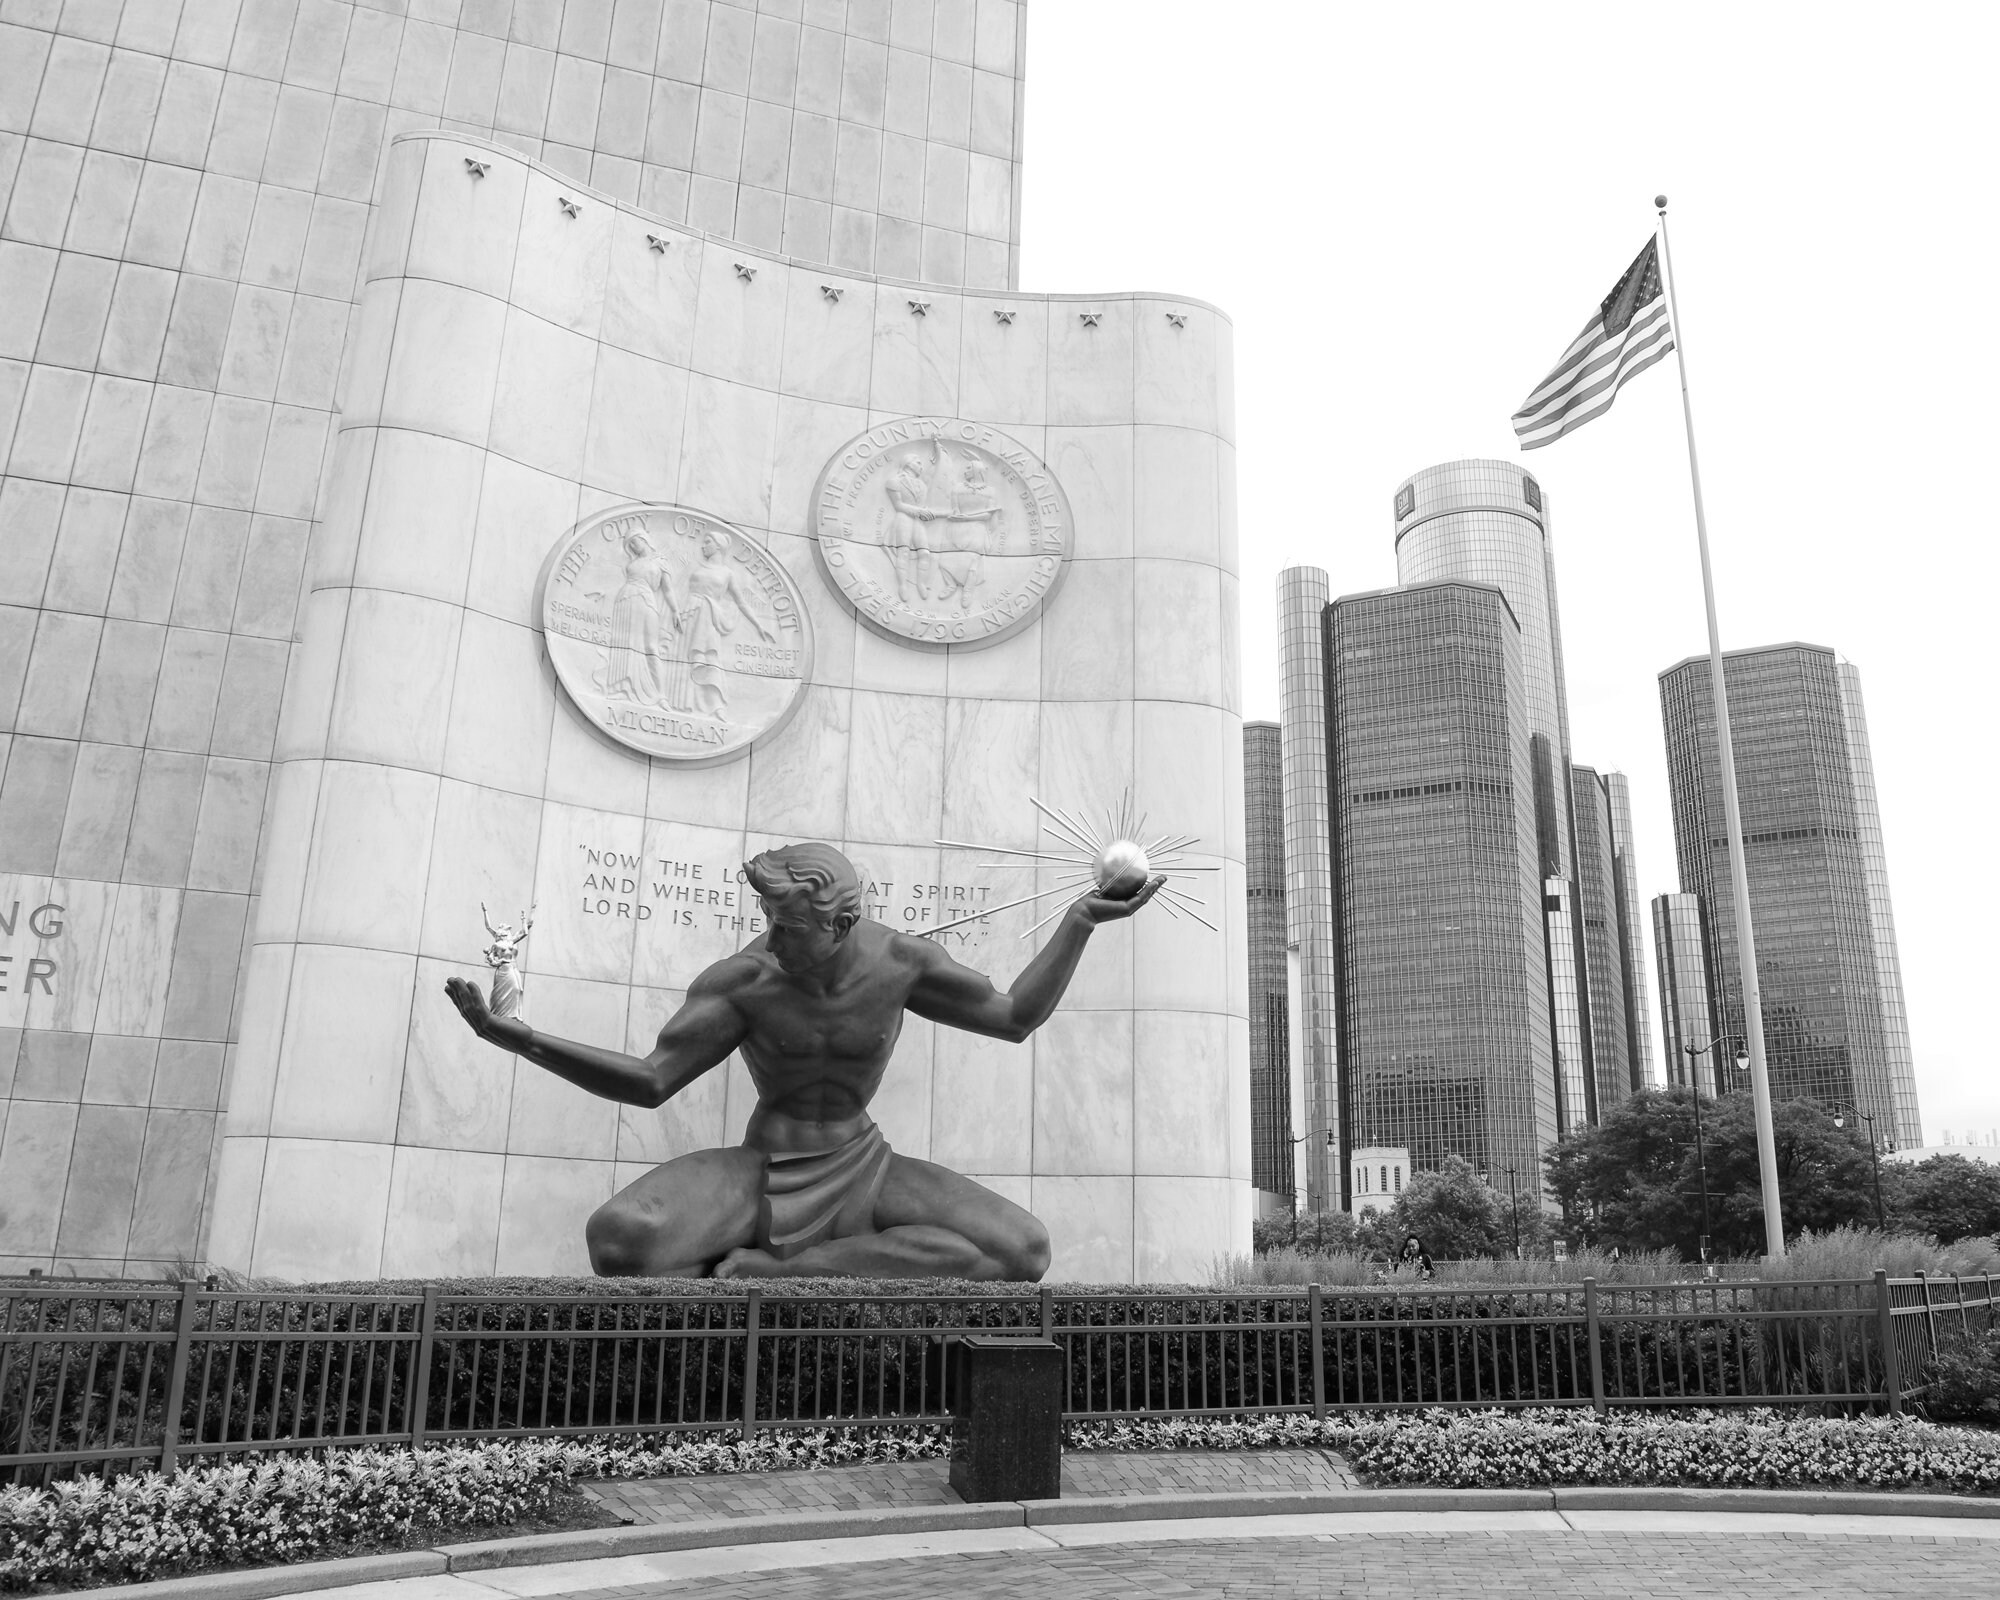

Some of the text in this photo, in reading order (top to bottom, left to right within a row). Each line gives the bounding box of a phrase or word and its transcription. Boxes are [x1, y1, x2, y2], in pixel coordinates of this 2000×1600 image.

[843, 419, 949, 470] COUNTY
[960, 424, 993, 445] OF
[847, 454, 894, 509] PRODUCE
[1019, 491, 1040, 547] DEFEND
[1000, 438, 1060, 515] WAYNE
[821, 477, 845, 527] THE
[555, 513, 799, 633] THE CITY OF DETROIT
[824, 537, 845, 568] OF
[844, 573, 897, 624] SEAL
[982, 523, 1062, 633] MICHIGAN
[606, 706, 728, 745] MICHIGAN
[583, 873, 635, 894] AND
[653, 882, 735, 907] WHERE
[903, 906, 931, 921] OF
[659, 859, 703, 880] THE
[912, 884, 990, 901] SPIRIT
[583, 897, 652, 920] LORD
